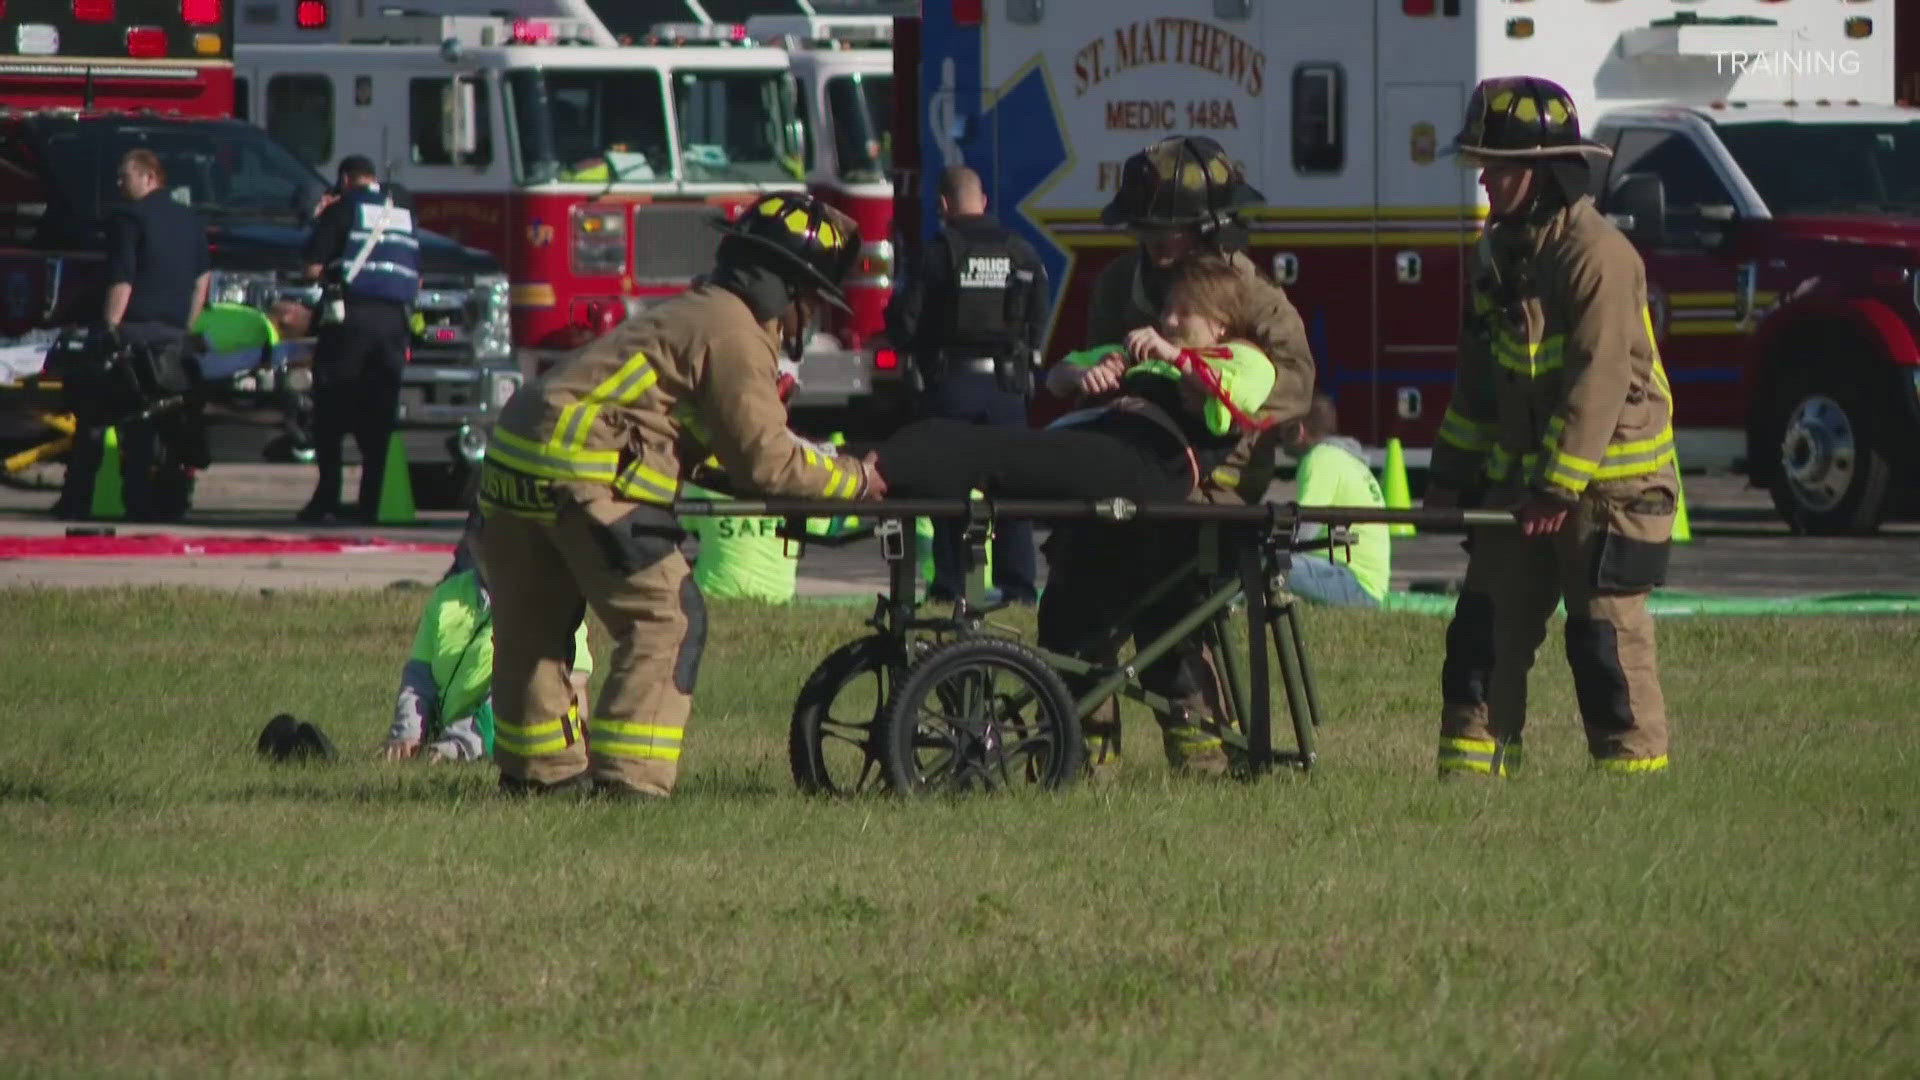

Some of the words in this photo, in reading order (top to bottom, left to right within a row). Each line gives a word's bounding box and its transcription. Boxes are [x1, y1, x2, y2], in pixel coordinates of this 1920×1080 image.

[1074, 37, 1110, 97] ST.
[1115, 17, 1266, 97] MATTHEWS
[1105, 100, 1176, 130] MEDIC
[1185, 100, 1238, 130] 148A
[968, 256, 1011, 273] POLICE
[719, 518, 784, 538] SAF
